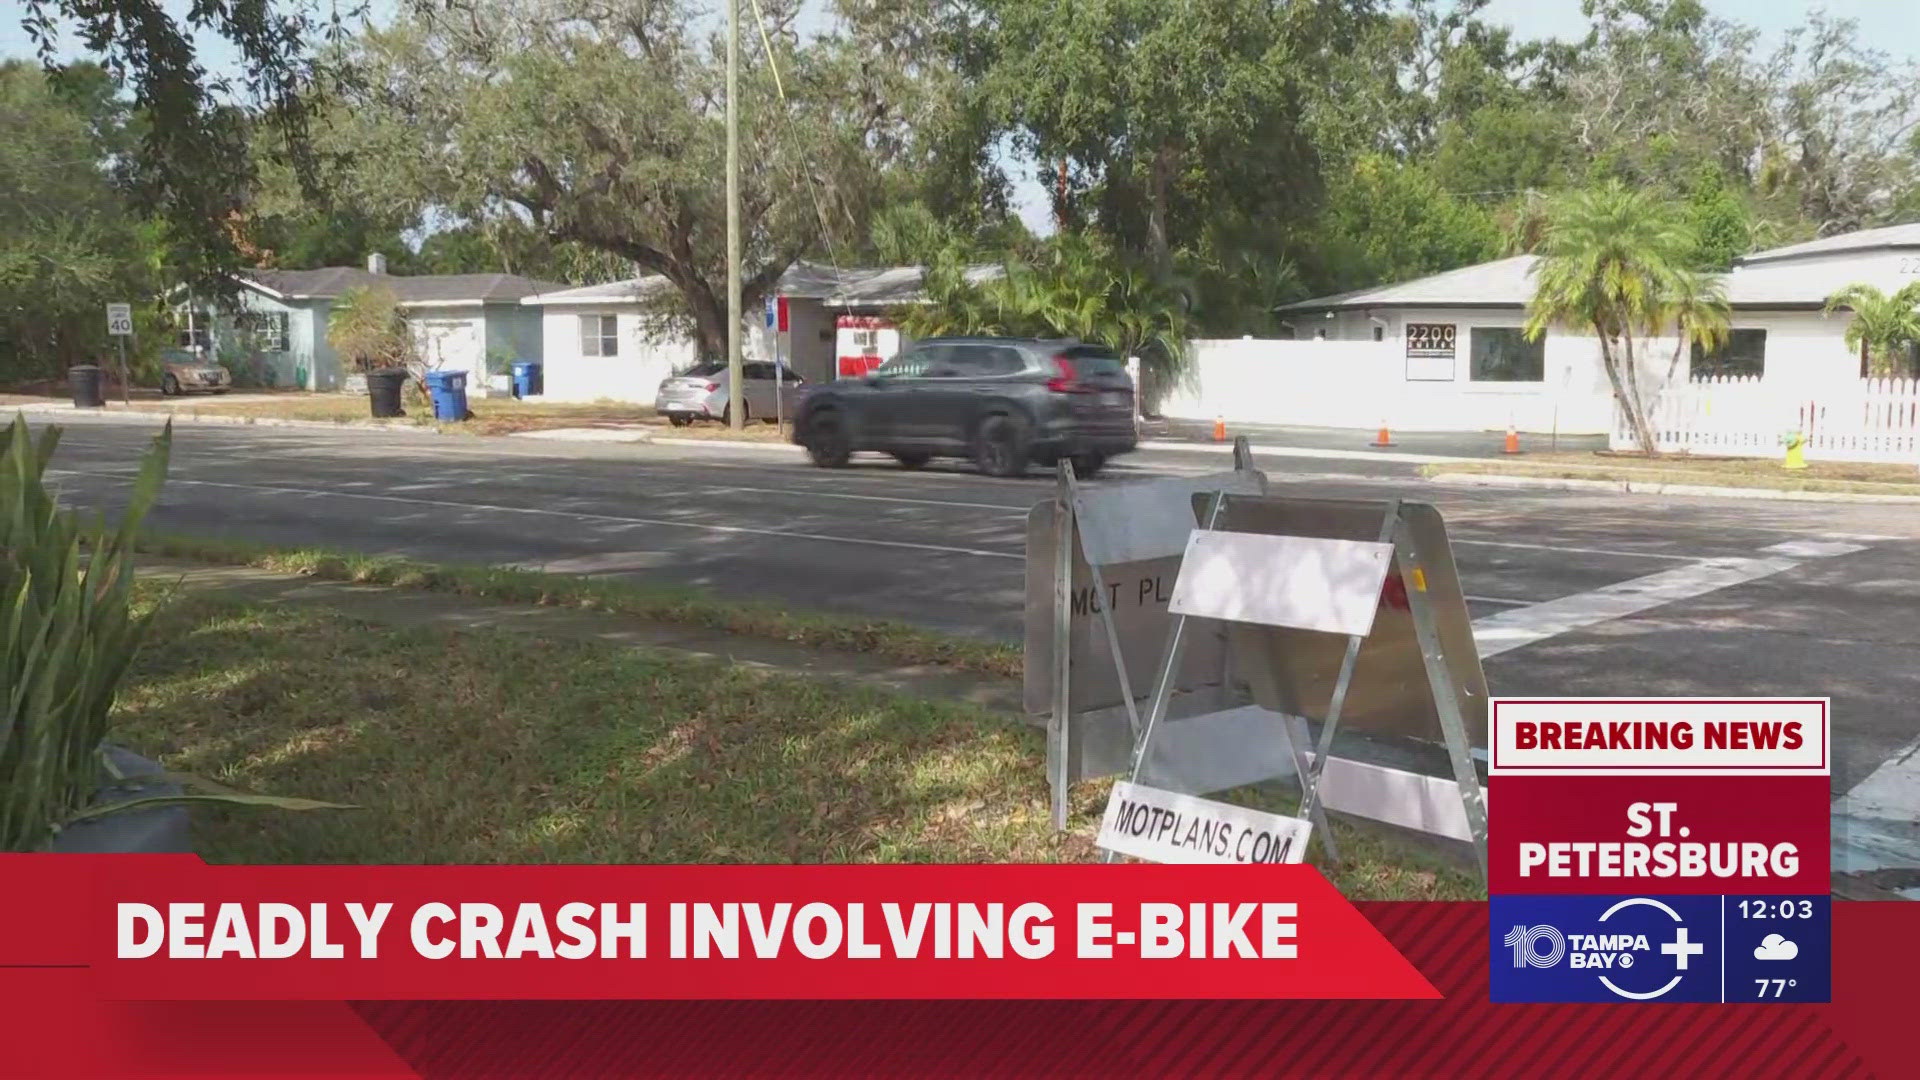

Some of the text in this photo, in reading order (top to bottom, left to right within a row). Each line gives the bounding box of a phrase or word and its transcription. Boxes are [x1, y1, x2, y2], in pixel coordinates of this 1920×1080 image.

[111, 319, 130, 332] 40
[1408, 326, 1454, 342] 2200
[1114, 800, 1294, 864] MOTPLANS.COM
